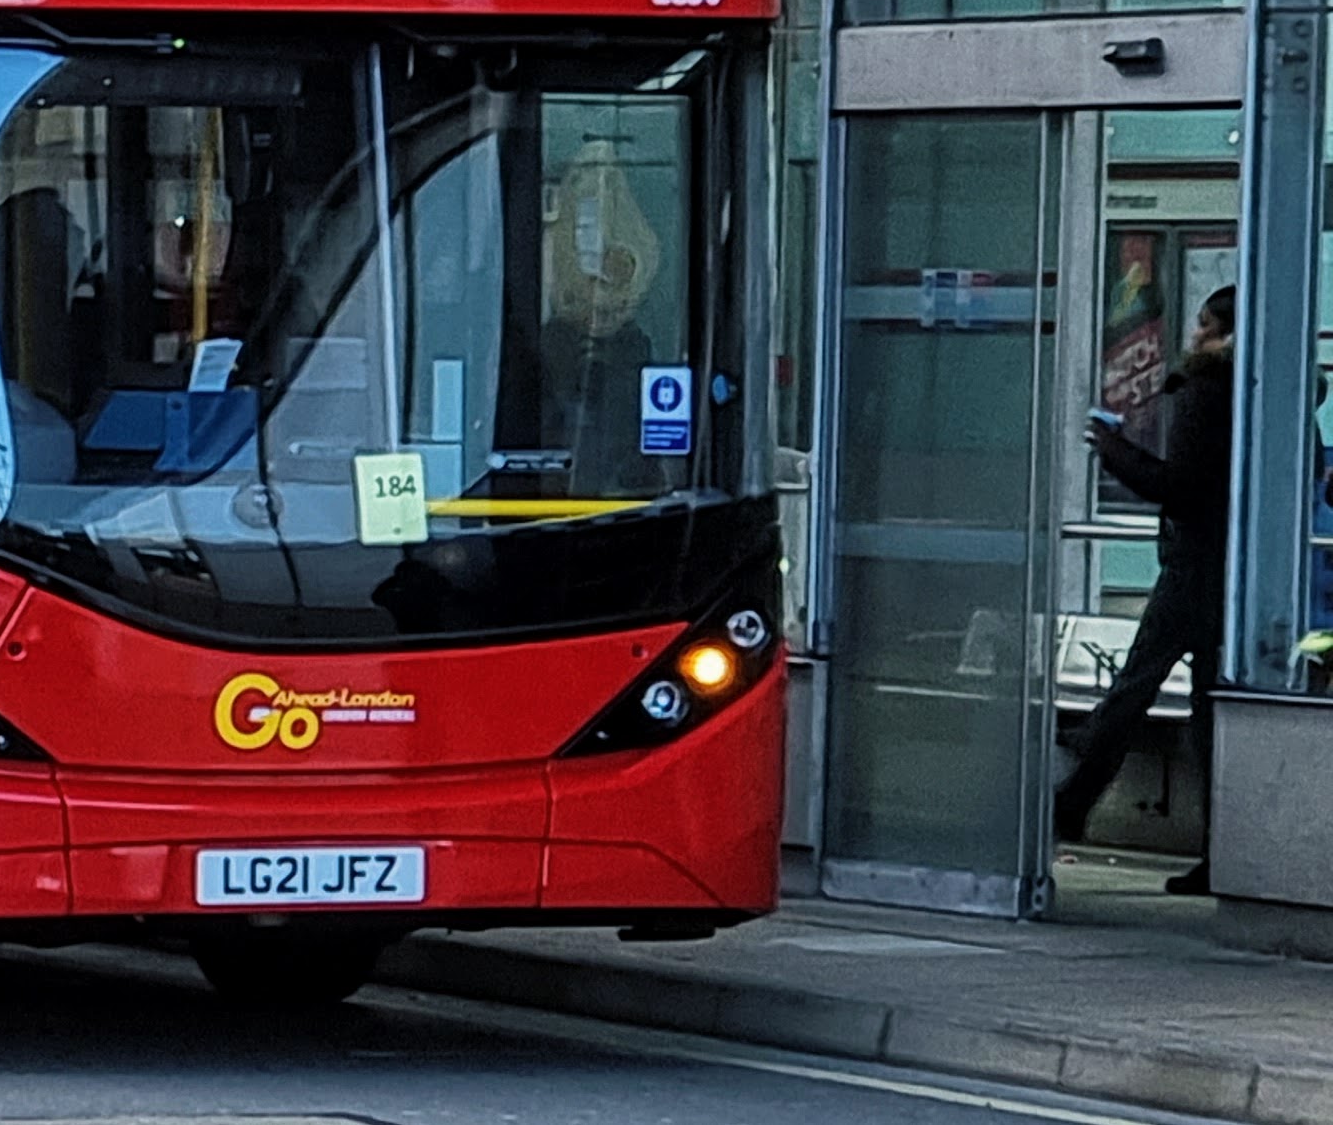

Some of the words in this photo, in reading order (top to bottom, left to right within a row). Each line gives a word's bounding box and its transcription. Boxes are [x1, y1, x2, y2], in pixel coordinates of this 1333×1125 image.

[374, 474, 417, 498] 184
[214, 672, 319, 750] Go
[223, 856, 310, 895] LG21
[322, 855, 398, 893] JFZ
